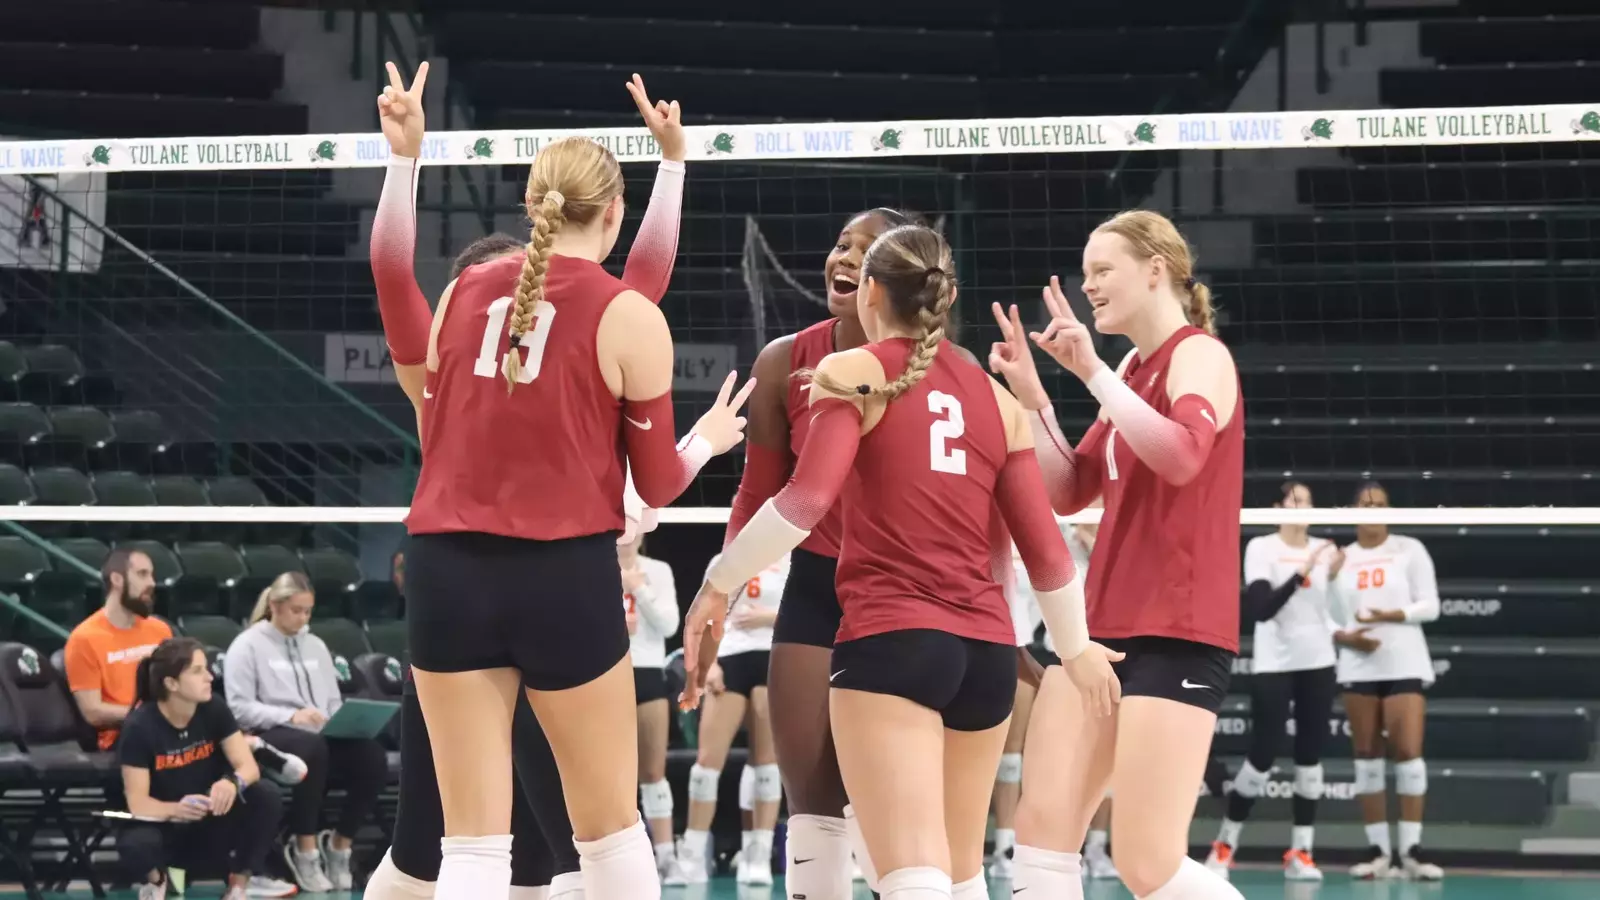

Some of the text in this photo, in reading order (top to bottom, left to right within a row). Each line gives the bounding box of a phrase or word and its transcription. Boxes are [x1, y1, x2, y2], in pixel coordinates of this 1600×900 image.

[923, 124, 1107, 149] TULANE VOLLEYBALL
[1178, 119, 1284, 143] ROLL WAVE
[1356, 113, 1552, 138] TULANE VOLLEYBALL
[755, 130, 854, 153] ROLL WAVE
[20, 147, 66, 168] WAVE
[128, 142, 293, 165] TULANE VOLLEYBALL
[473, 296, 557, 385] 19
[927, 390, 967, 476] 2
[747, 576, 760, 599] 6
[1357, 567, 1385, 590] 20
[1441, 599, 1502, 616] GROUP
